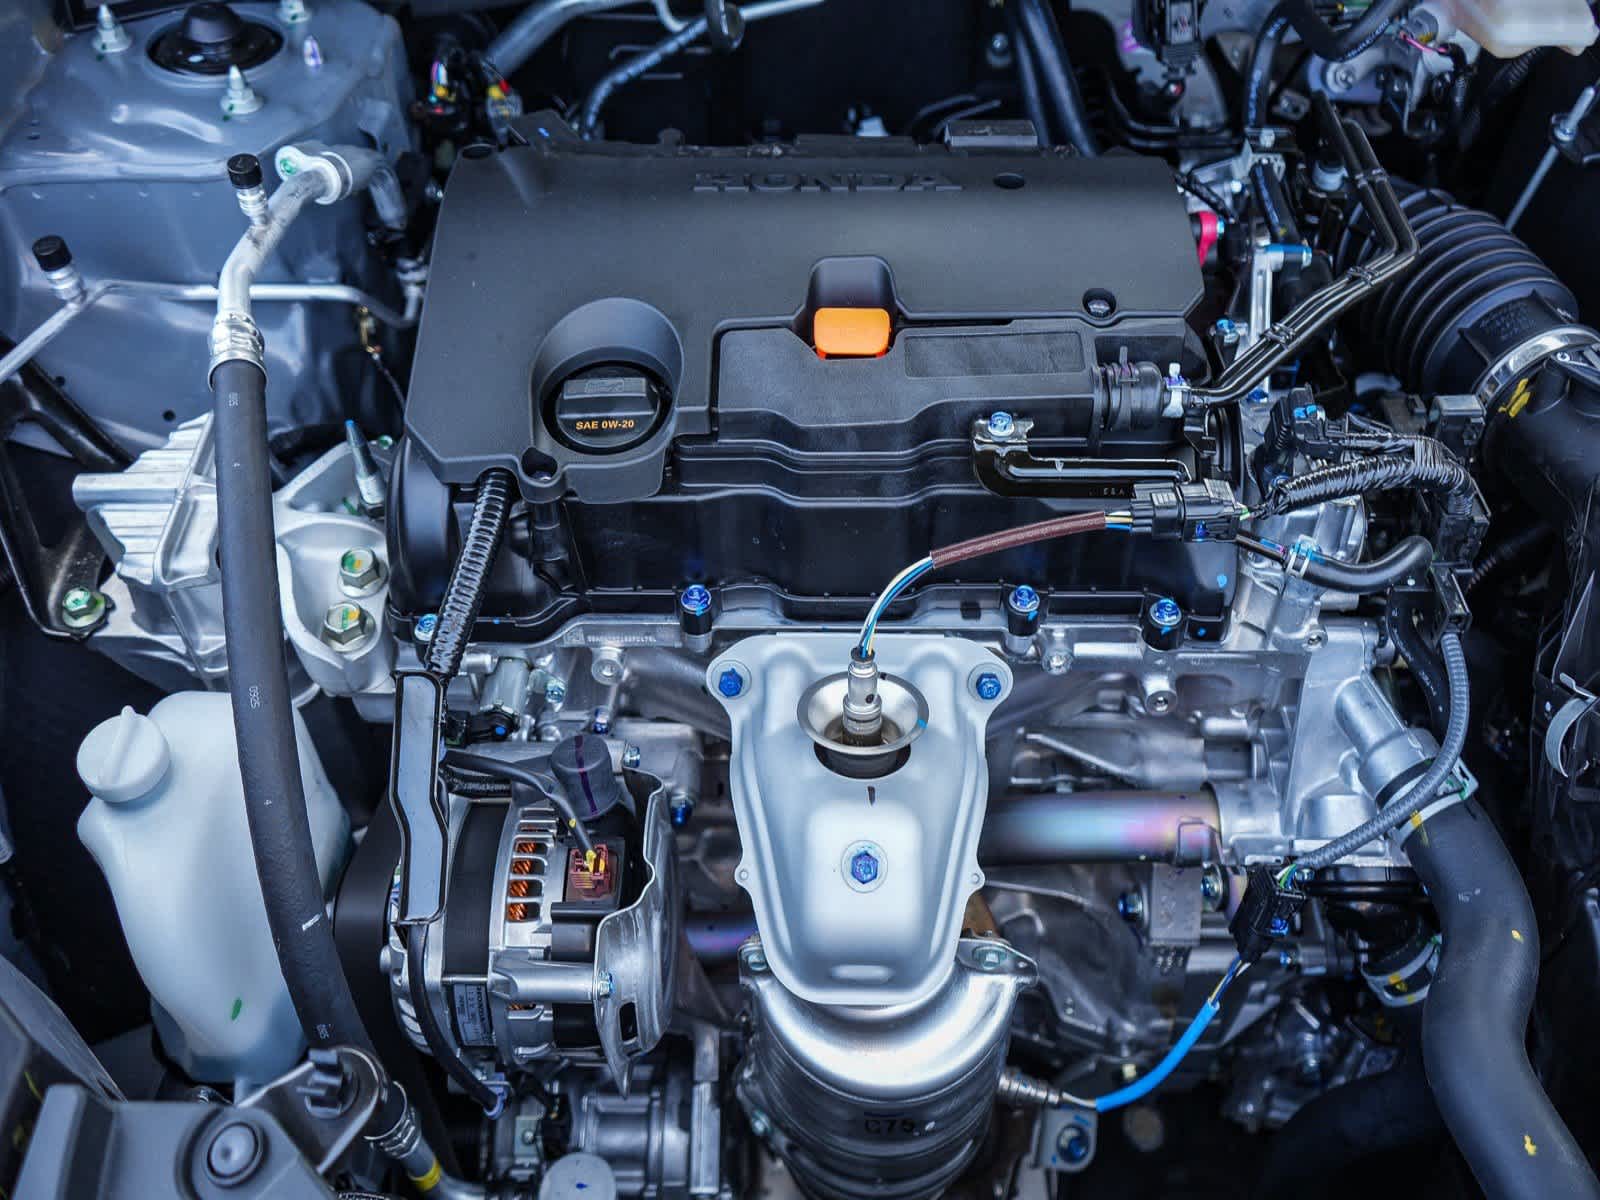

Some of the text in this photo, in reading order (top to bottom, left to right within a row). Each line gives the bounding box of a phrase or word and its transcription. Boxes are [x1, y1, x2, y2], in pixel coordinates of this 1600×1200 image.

[693, 172, 963, 192] HONDA
[575, 419, 635, 431] SAE 0W-20
